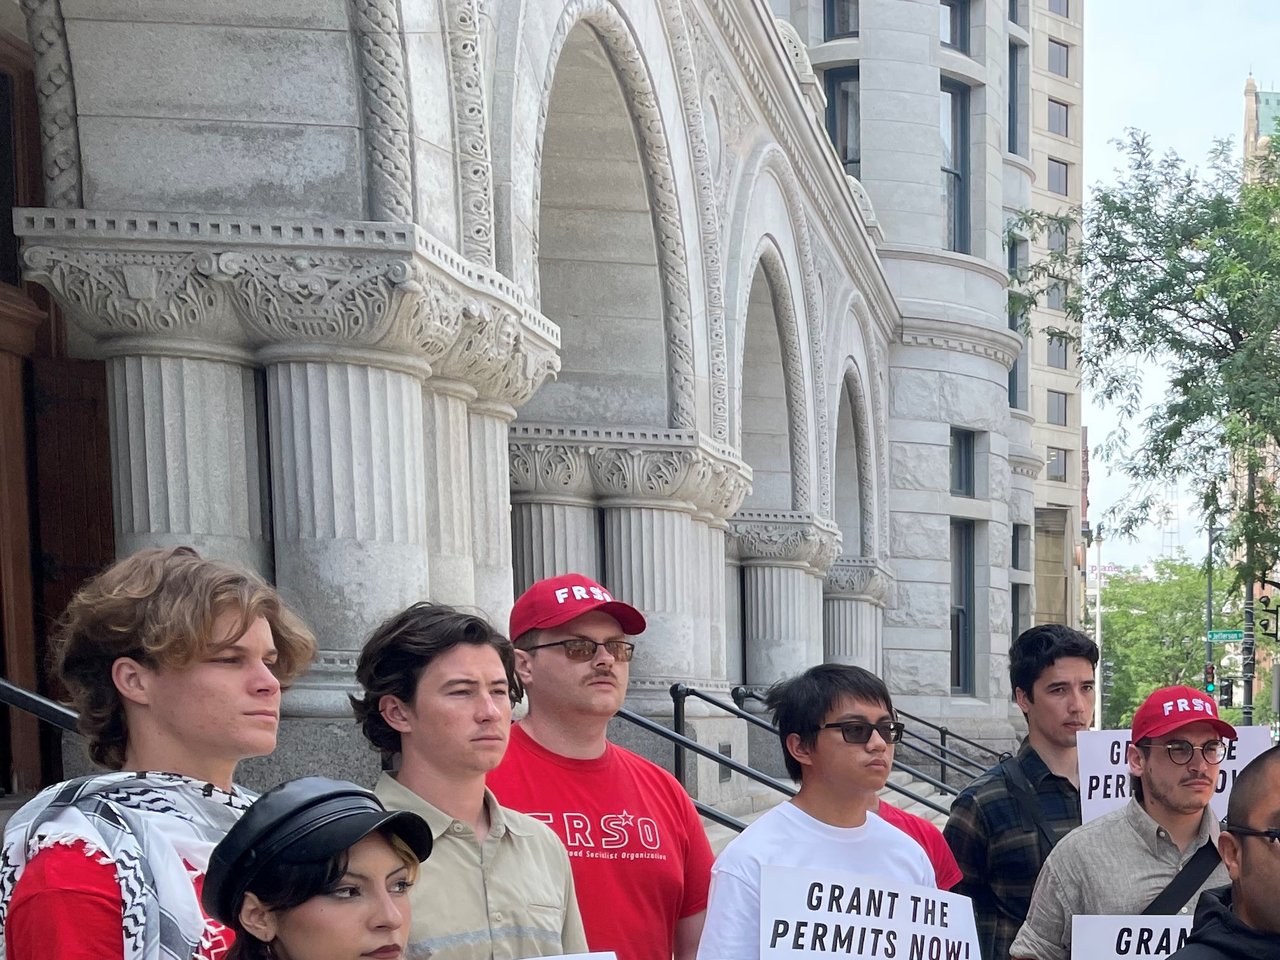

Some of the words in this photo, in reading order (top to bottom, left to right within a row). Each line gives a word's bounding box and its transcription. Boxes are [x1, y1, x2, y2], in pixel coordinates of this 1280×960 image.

[806, 881, 899, 920] GRANT
[910, 895, 949, 928] THE
[770, 919, 897, 959] PERMITS
[1115, 927, 1193, 956] GRAN
